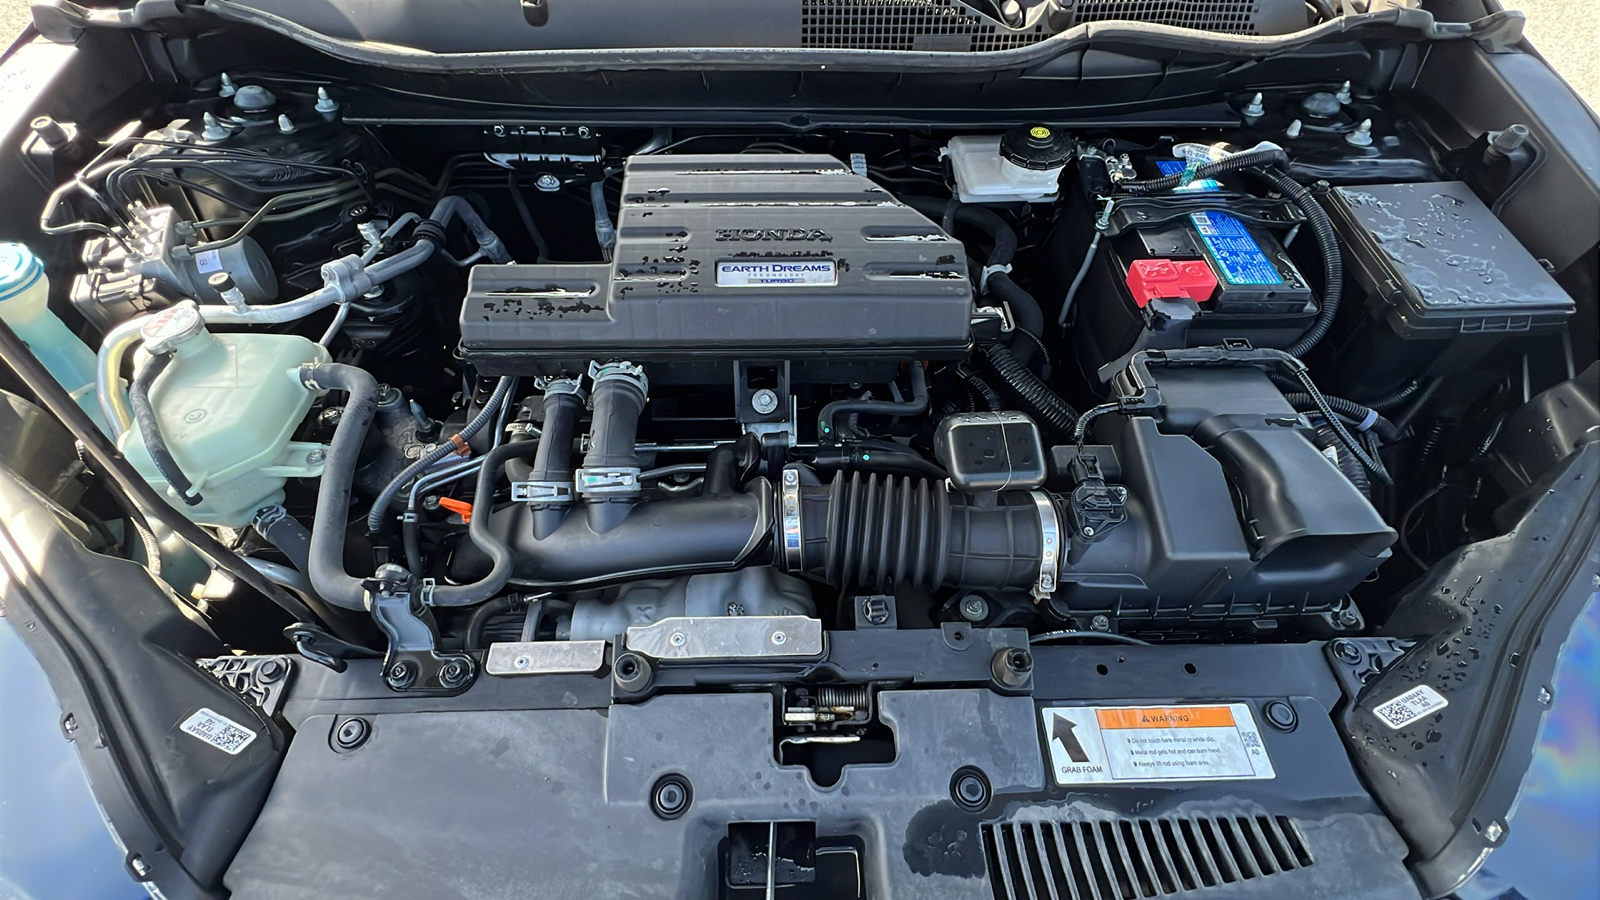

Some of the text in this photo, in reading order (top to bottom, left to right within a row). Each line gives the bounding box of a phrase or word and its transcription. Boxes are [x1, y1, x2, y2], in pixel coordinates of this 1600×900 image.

[715, 228, 833, 242] HONDA
[721, 263, 831, 272] EARTH DREAMS
